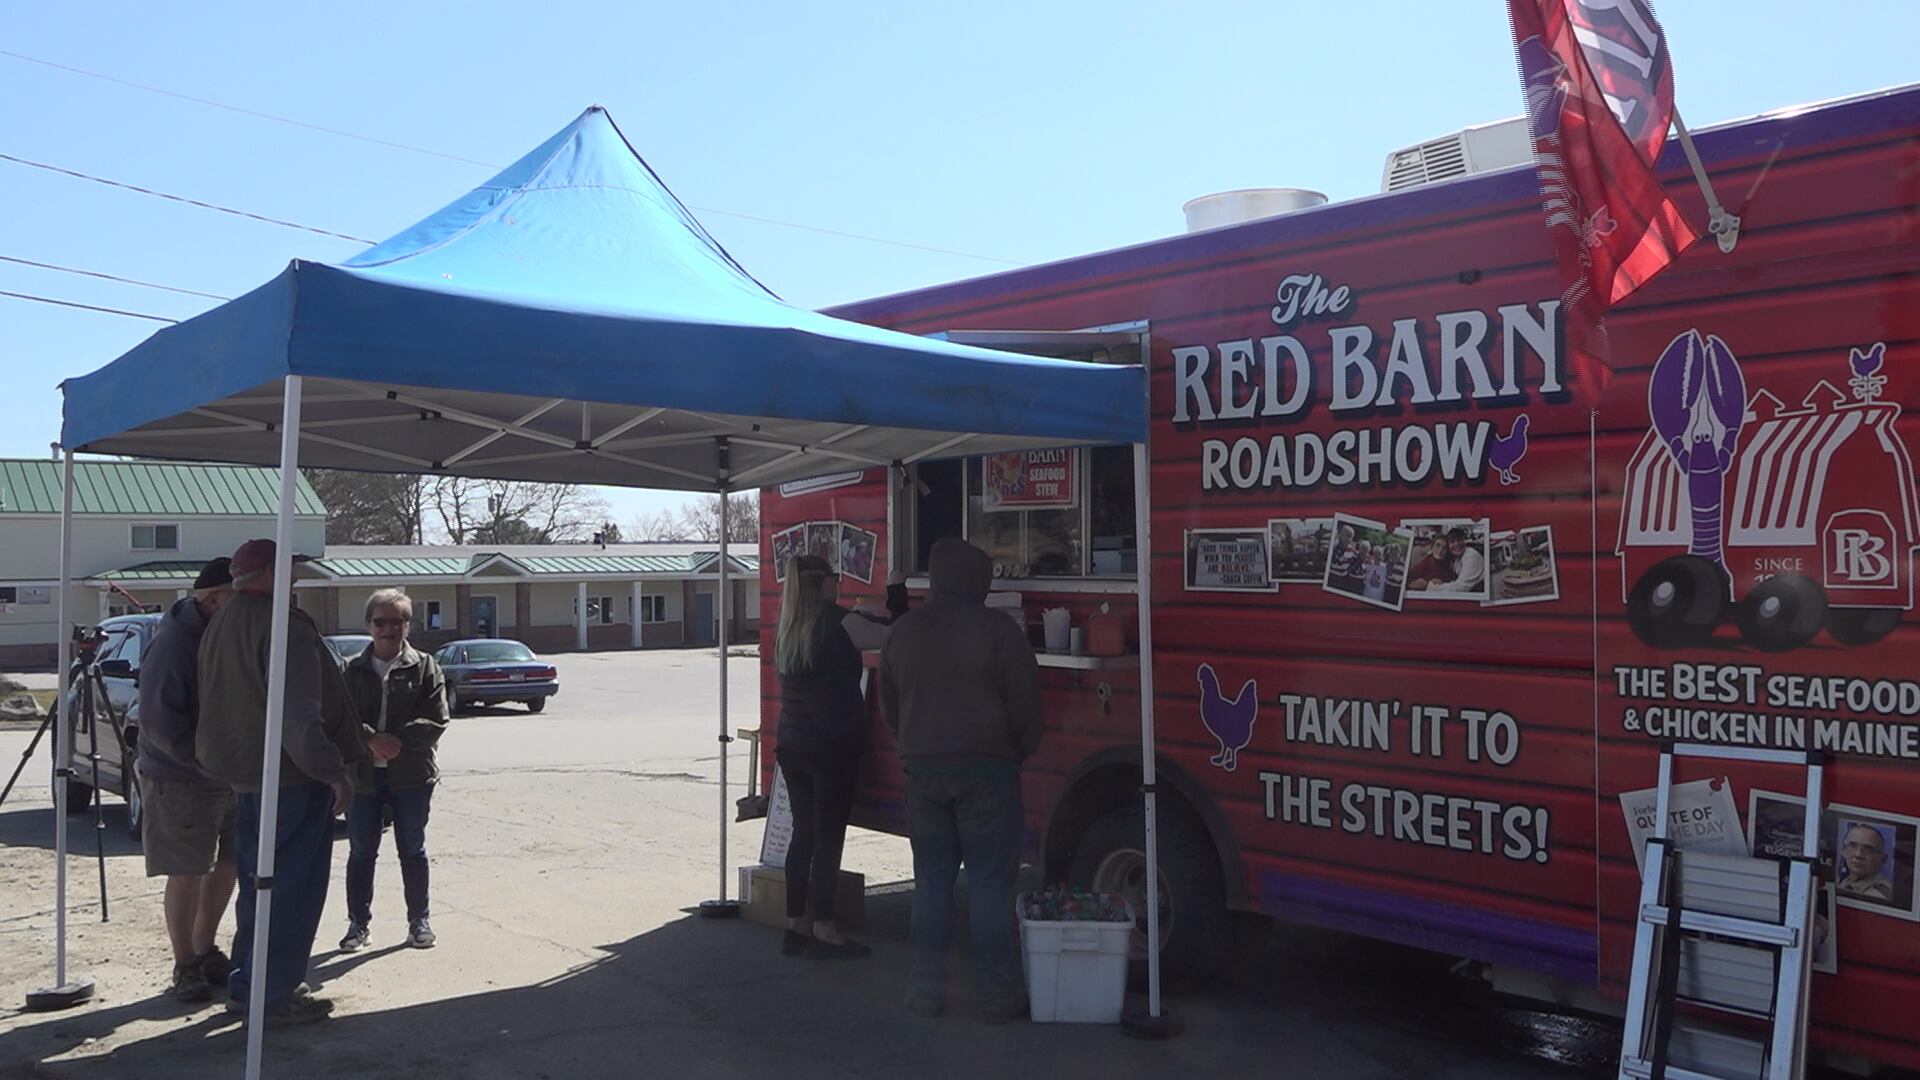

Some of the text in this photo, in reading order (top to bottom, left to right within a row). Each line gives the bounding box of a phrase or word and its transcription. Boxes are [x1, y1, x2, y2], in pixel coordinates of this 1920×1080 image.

[1271, 273, 1350, 325] The
[1172, 300, 1561, 423] RED BARN
[1029, 467, 1066, 481] SEAFOOD
[1202, 421, 1490, 490] ROADSHOW
[1035, 483, 1060, 496] STEW
[1754, 558, 1804, 571] SINCE
[1614, 663, 1920, 716] THE BEST SEAFOOD
[1279, 694, 1519, 765] TAKIN' IT TO
[1624, 707, 1919, 758] & CHICKEN IN MAINE
[1259, 772, 1549, 864] THE STREETS!
[1636, 806, 1713, 829] QUTE OF
[1670, 819, 1725, 840] HE DAY
[1764, 845, 1804, 857] EUGEN
